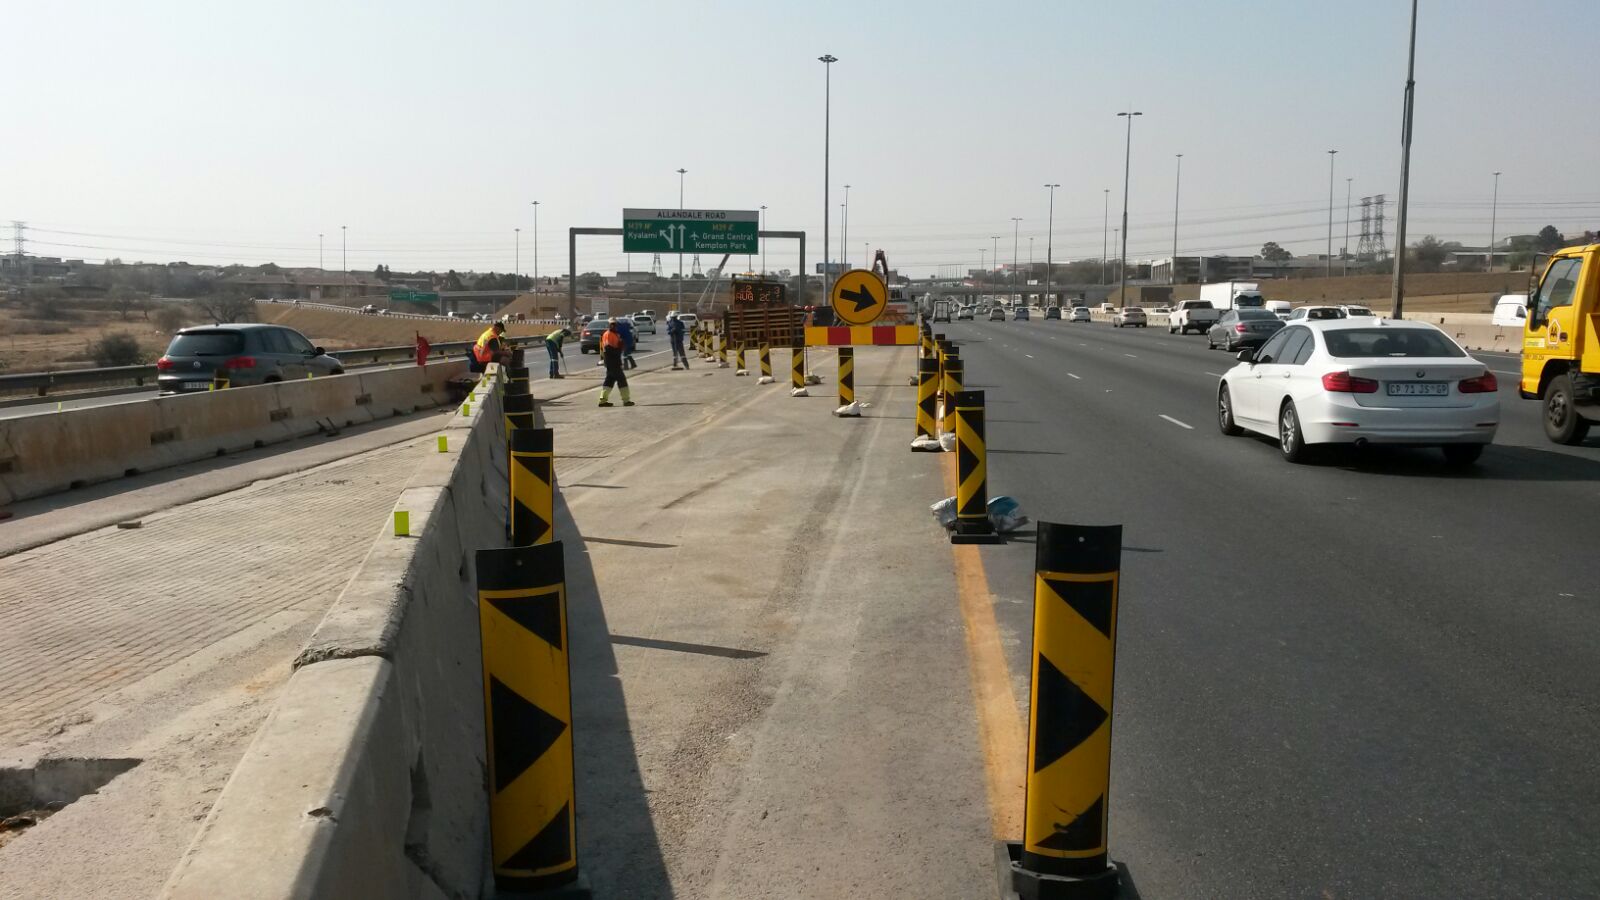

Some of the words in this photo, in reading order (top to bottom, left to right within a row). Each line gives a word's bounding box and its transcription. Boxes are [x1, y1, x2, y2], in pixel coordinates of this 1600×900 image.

[628, 232, 658, 240] Kyalami
[702, 232, 725, 240] Grand
[726, 233, 754, 241] Central
[695, 241, 728, 250] Kempton
[730, 242, 747, 250] Park
